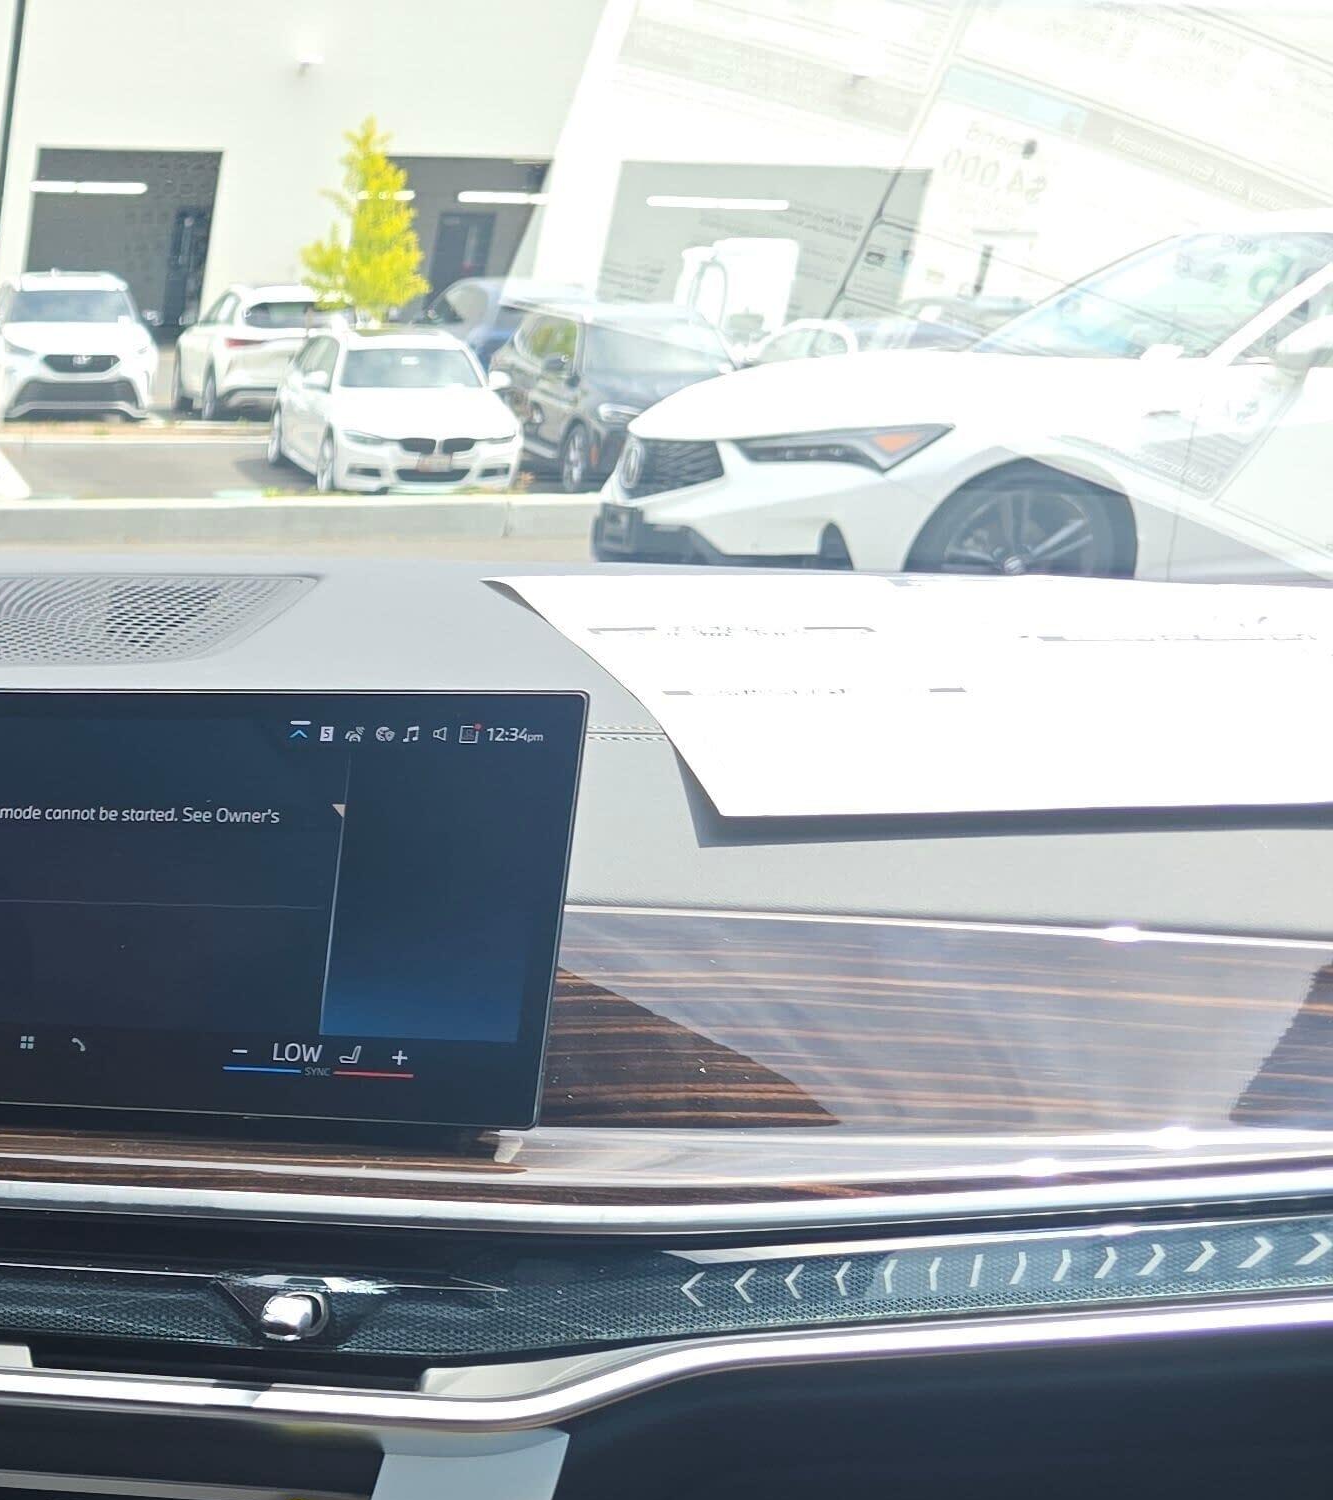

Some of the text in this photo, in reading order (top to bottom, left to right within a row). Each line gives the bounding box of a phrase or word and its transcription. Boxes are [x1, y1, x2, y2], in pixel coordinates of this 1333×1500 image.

[0, 806, 42, 820] mode
[45, 807, 96, 822] cannot
[98, 806, 119, 822] be
[121, 808, 179, 823] started.
[182, 807, 213, 823] See
[215, 808, 280, 824] Owner's
[272, 1042, 323, 1062] LOW
[304, 1066, 331, 1077] SYNC
